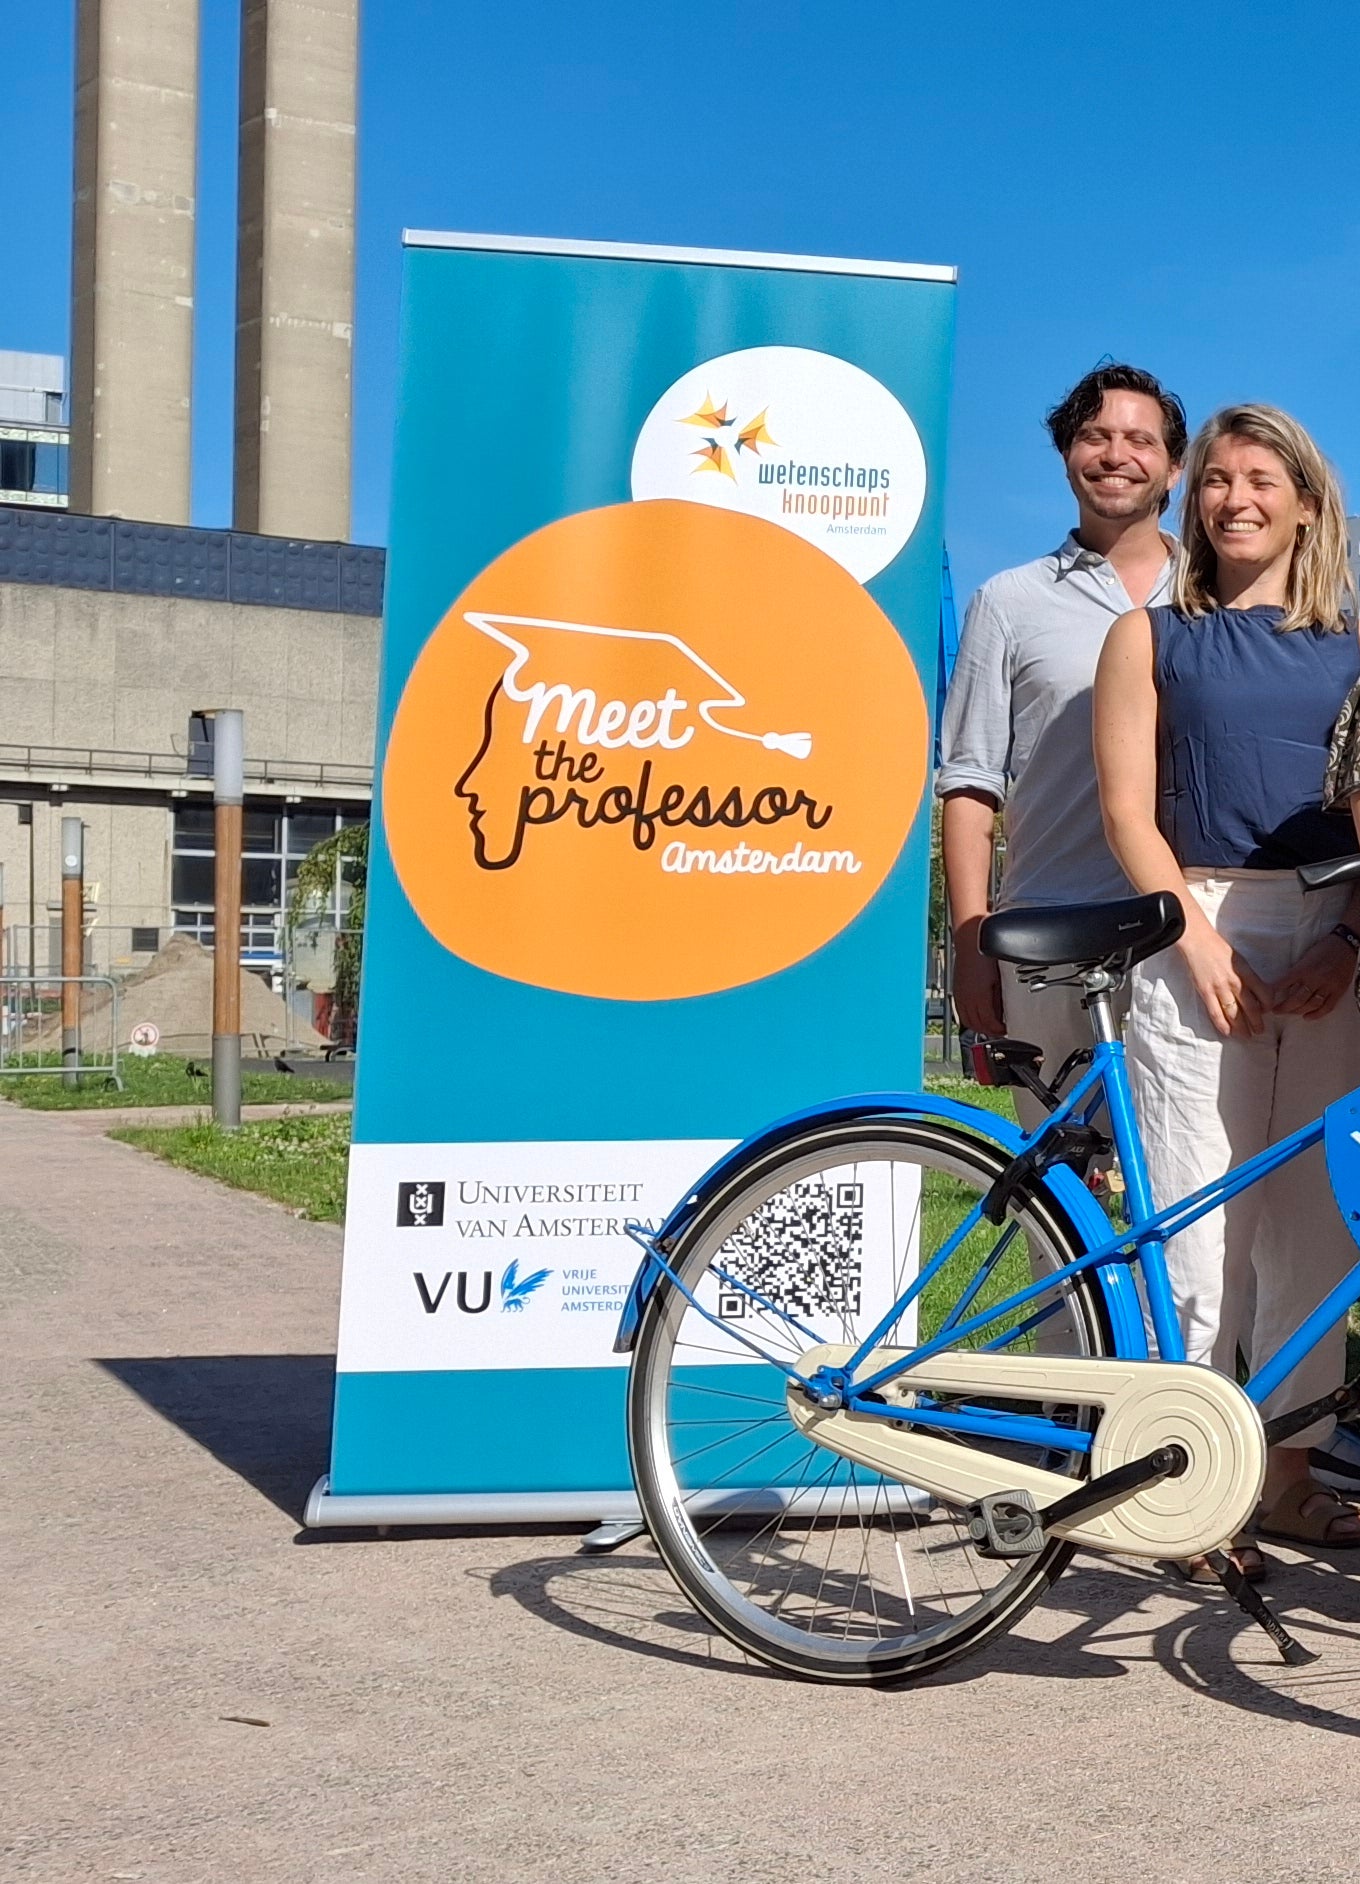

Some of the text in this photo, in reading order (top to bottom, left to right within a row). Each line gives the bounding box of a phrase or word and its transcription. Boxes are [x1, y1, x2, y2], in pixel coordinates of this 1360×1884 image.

[758, 460, 891, 492] wetenschaps
[781, 488, 890, 520] knooppunt
[826, 522, 888, 536] Amsterdam
[521, 682, 694, 750] Meet
[534, 739, 604, 783] the
[518, 760, 833, 852] professor
[660, 841, 861, 875] Amsterdam
[457, 1180, 644, 1205] UNIVERSITEIT
[456, 1219, 508, 1239] VAN
[562, 1268, 597, 1280] VRIJE
[413, 1271, 493, 1315] VU
